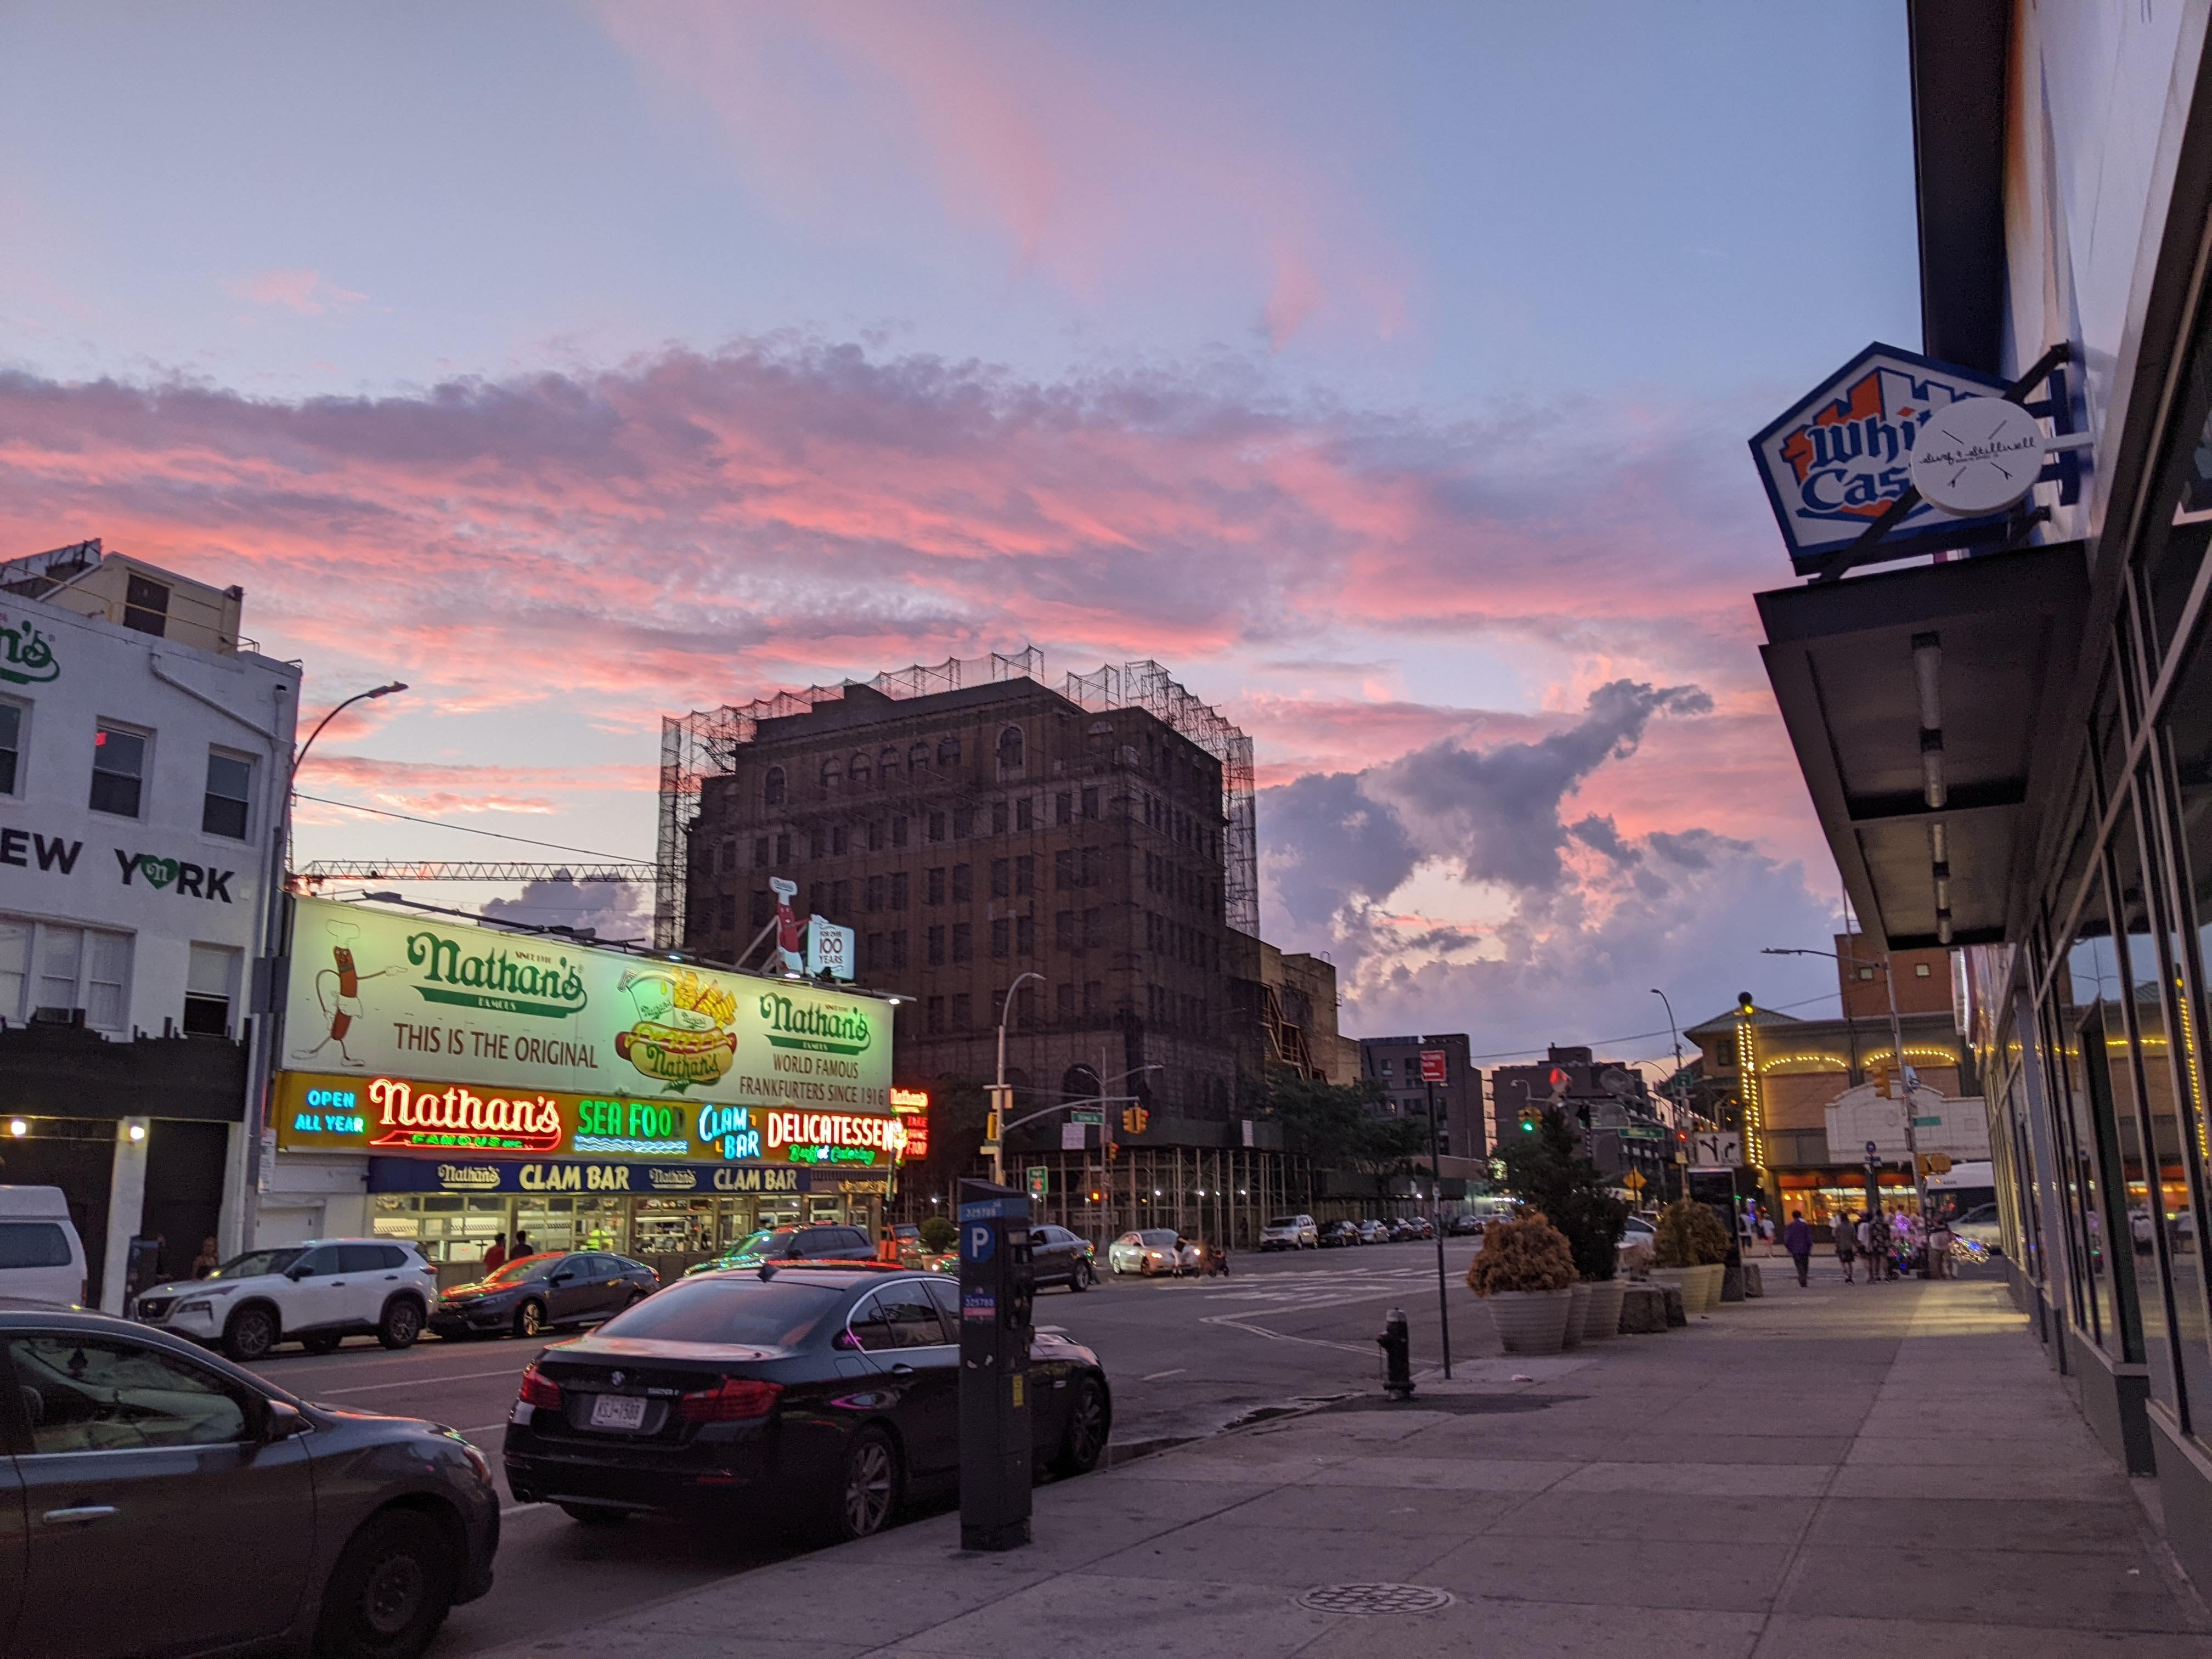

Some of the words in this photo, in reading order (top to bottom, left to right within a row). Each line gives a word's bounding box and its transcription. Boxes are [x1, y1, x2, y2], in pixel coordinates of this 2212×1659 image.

[1807, 407, 1932, 469] Whi
[819, 955, 843, 964] YEARS
[820, 938, 843, 953] 100
[407, 932, 586, 1003] Nathan's
[478, 997, 517, 1011] FAMOUS
[760, 992, 871, 1042] Nathan's
[393, 1023, 441, 1052] THIS
[448, 1029, 464, 1055] IS
[471, 1031, 509, 1060] THE
[515, 1036, 599, 1069] ORIGINAL
[647, 1043, 720, 1078] Nathan's
[773, 1053, 812, 1074] WORLD
[816, 1059, 859, 1079] FAMOUS
[308, 1091, 354, 1108] OPEN
[740, 1076, 825, 1101] FRANKFURTERS
[828, 1084, 857, 1103] SINCE
[861, 1087, 884, 1105] 1916
[369, 1078, 560, 1134] Nathan's
[578, 1100, 622, 1135] SEA
[295, 1114, 321, 1131] ALL
[325, 1115, 363, 1132] YEAR
[699, 1104, 747, 1142] CLAM
[768, 1112, 894, 1152] DELICATESSEN
[412, 1133, 501, 1147] FAMOUS
[725, 1130, 760, 1159] BAR
[438, 1164, 500, 1184] Nathan's
[520, 1164, 582, 1190] CLAM
[586, 1165, 630, 1190] BAR
[714, 1169, 760, 1190] CLAM
[764, 1169, 798, 1190] BAR
[971, 1227, 989, 1257] P
